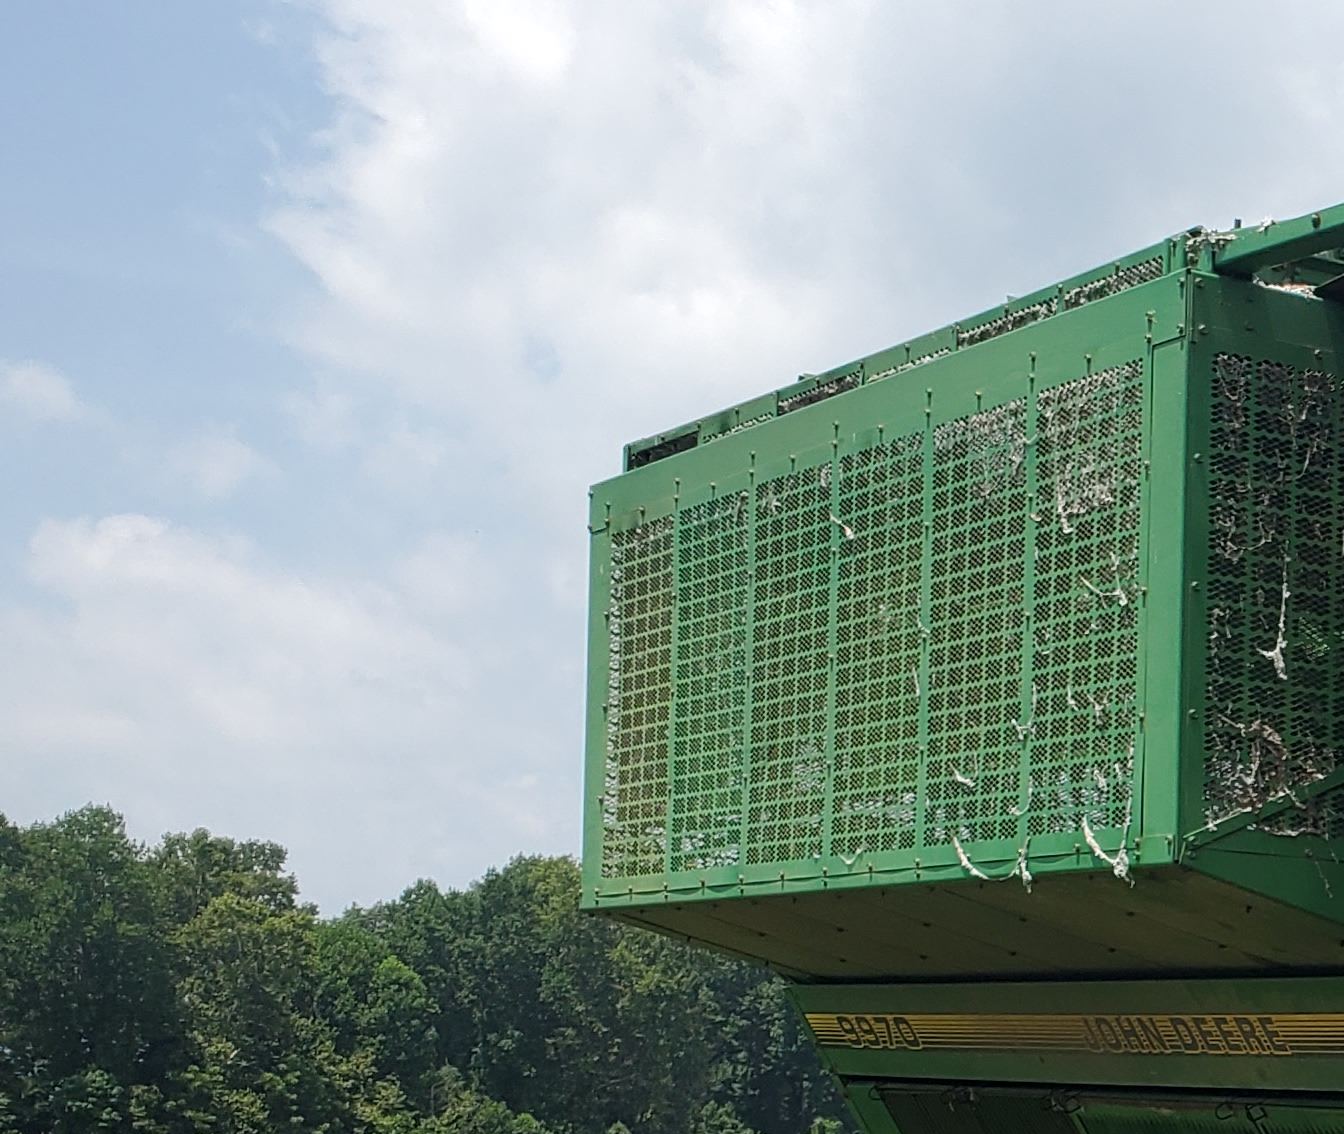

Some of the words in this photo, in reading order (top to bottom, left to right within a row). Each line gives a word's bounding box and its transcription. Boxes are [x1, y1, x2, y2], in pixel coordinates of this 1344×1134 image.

[836, 1015, 922, 1049] 9970
[1083, 1016, 1172, 1054] JOHN
[1168, 1016, 1292, 1055] DEERE
